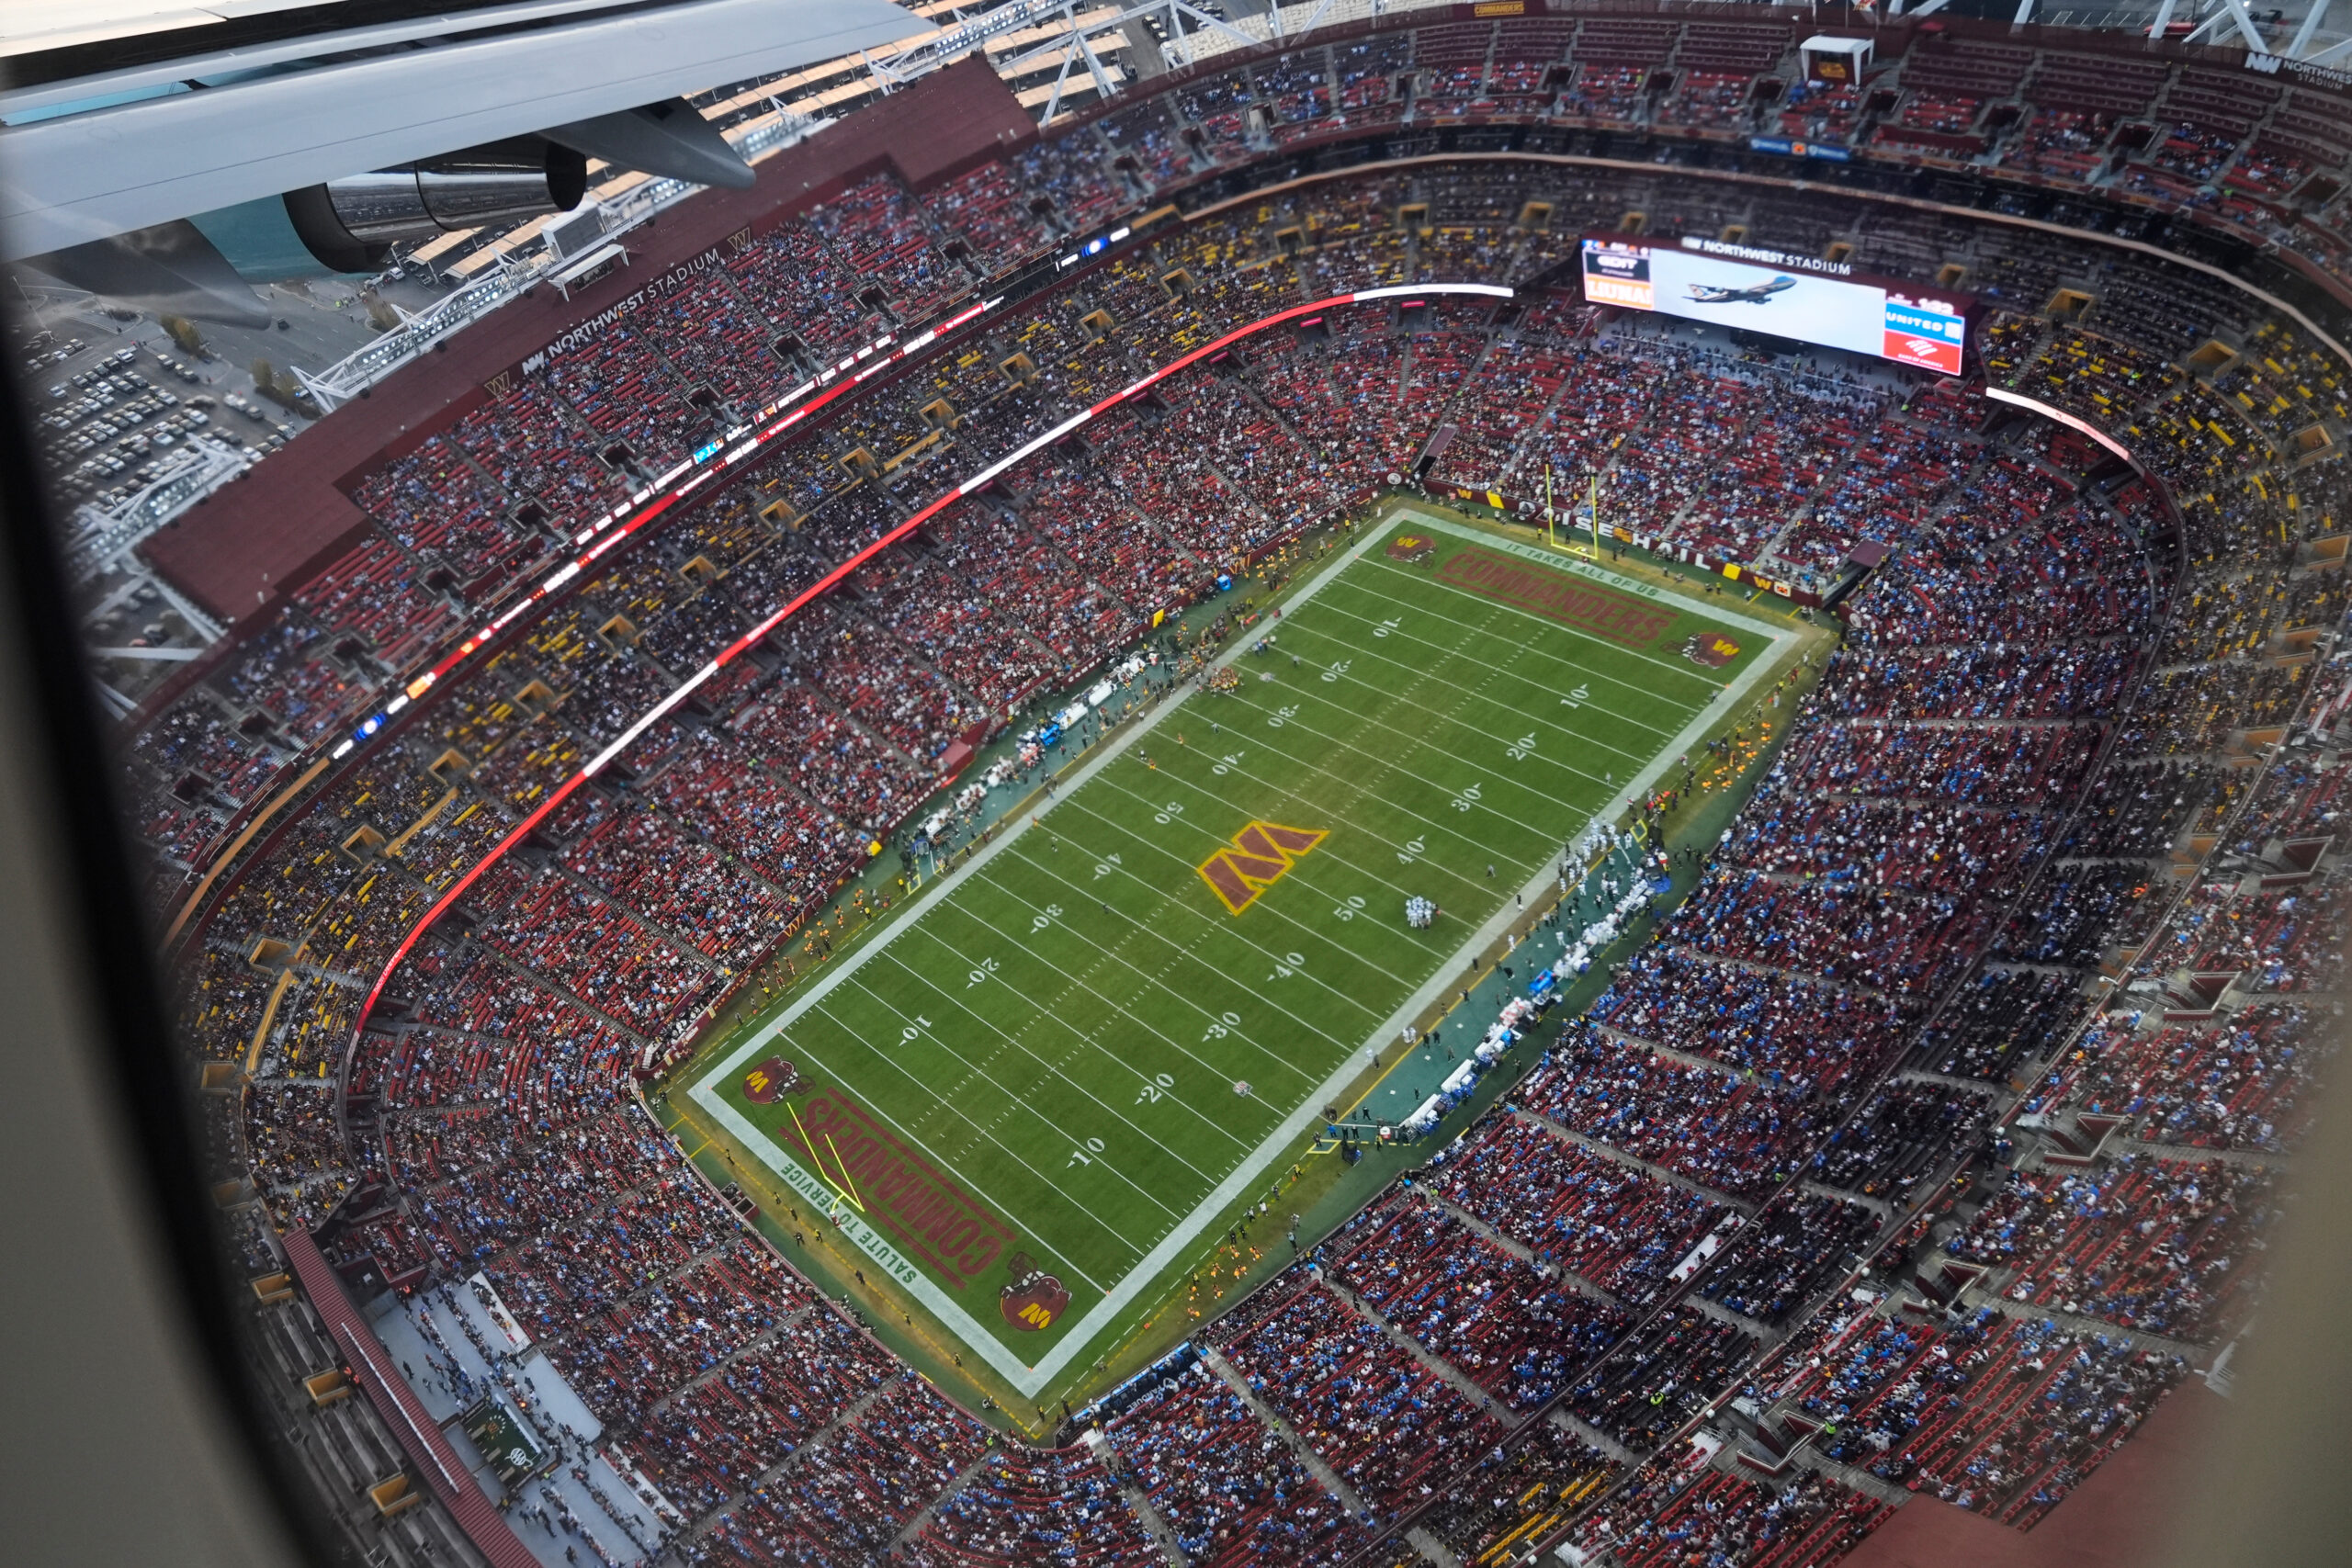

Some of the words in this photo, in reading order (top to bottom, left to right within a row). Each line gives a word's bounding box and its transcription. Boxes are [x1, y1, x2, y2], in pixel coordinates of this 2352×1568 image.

[2283, 60, 2352, 85] NORTHWES
[2298, 73, 2344, 90] STADIUM
[1703, 240, 1785, 264] NORTHWEST
[1786, 254, 1851, 276] STADIUM
[548, 290, 644, 359] NORTHWEST
[647, 248, 719, 299] STADIUM
[1886, 311, 1943, 332] UNITED
[1632, 533, 1712, 570] HAIL
[1506, 543, 1520, 552] IT
[1526, 547, 1574, 570] TAKES
[1577, 564, 1606, 579] ALL
[1611, 576, 1631, 590] OF
[1636, 584, 1659, 597] US
[1442, 553, 1669, 641] COMMANDERS
[1374, 620, 1397, 637] 10
[1321, 661, 1348, 682] 20
[1560, 689, 1589, 709] 10
[1268, 707, 1295, 728] 30
[1506, 738, 1535, 761] 20
[1212, 754, 1238, 775] 40
[888, 775, 948, 828] WASHINGTON
[1451, 788, 1481, 811] 30
[1154, 801, 1184, 824] 50
[1095, 852, 1122, 875] 40
[1396, 840, 1425, 864] 40
[1034, 904, 1063, 928] 30
[1333, 896, 1366, 921] 50
[969, 957, 1000, 982] 20
[1275, 952, 1305, 978] 40
[902, 1015, 932, 1040] 10
[1207, 1012, 1240, 1039] 30
[1140, 1073, 1174, 1103] 20
[1072, 1137, 1105, 1167] 10
[781, 1162, 840, 1215] SERVICE
[791, 1097, 1001, 1276] COMMANDERS
[839, 1213, 860, 1234] TO
[858, 1233, 918, 1284] SALUTE
[1125, 1385, 1163, 1410] FANDUEL
